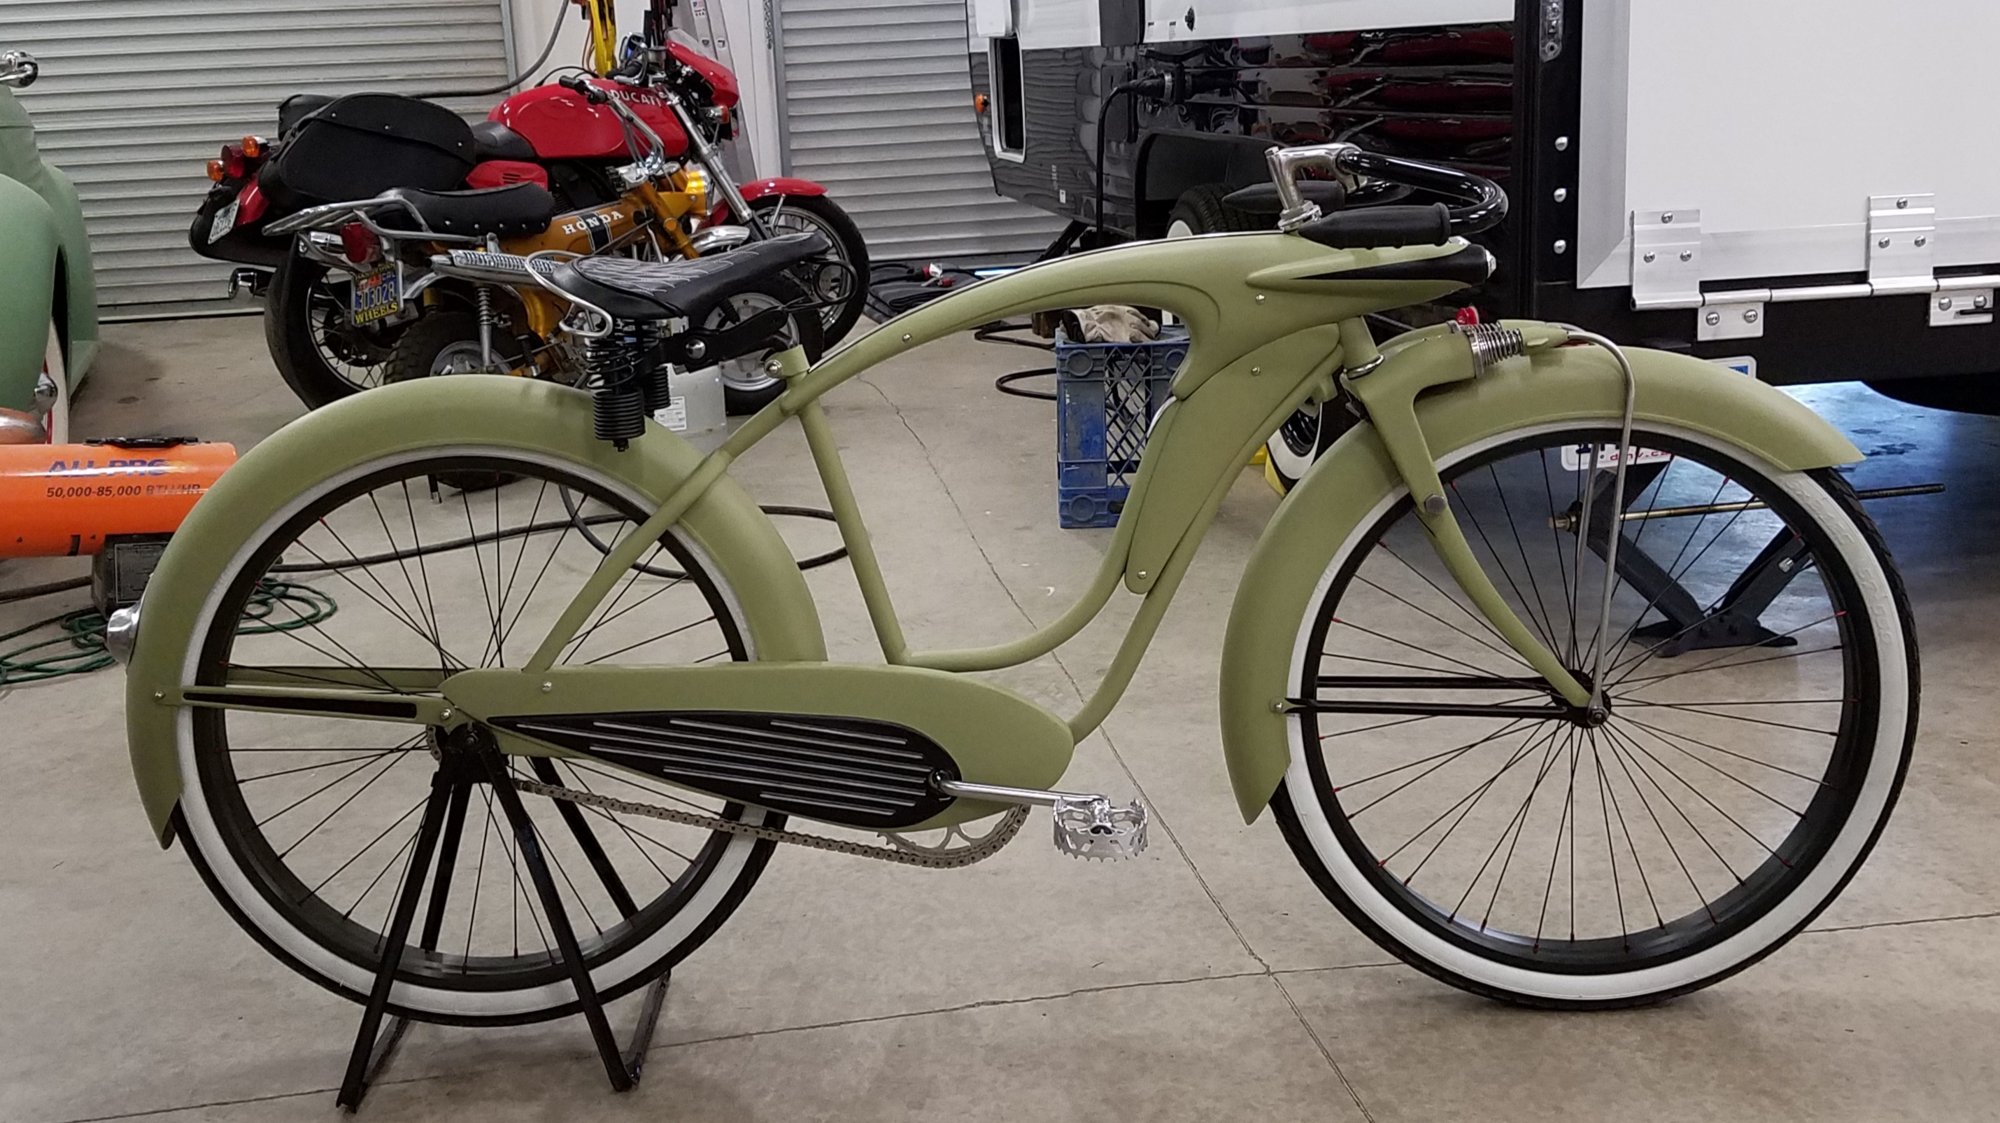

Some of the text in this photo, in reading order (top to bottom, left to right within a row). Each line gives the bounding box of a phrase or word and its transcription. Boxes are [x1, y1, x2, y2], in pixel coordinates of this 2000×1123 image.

[609, 89, 661, 107] DUCATI
[563, 209, 625, 235] HONDA
[355, 302, 399, 324] WHEELS
[46, 485, 142, 499] 50,000-85,000
